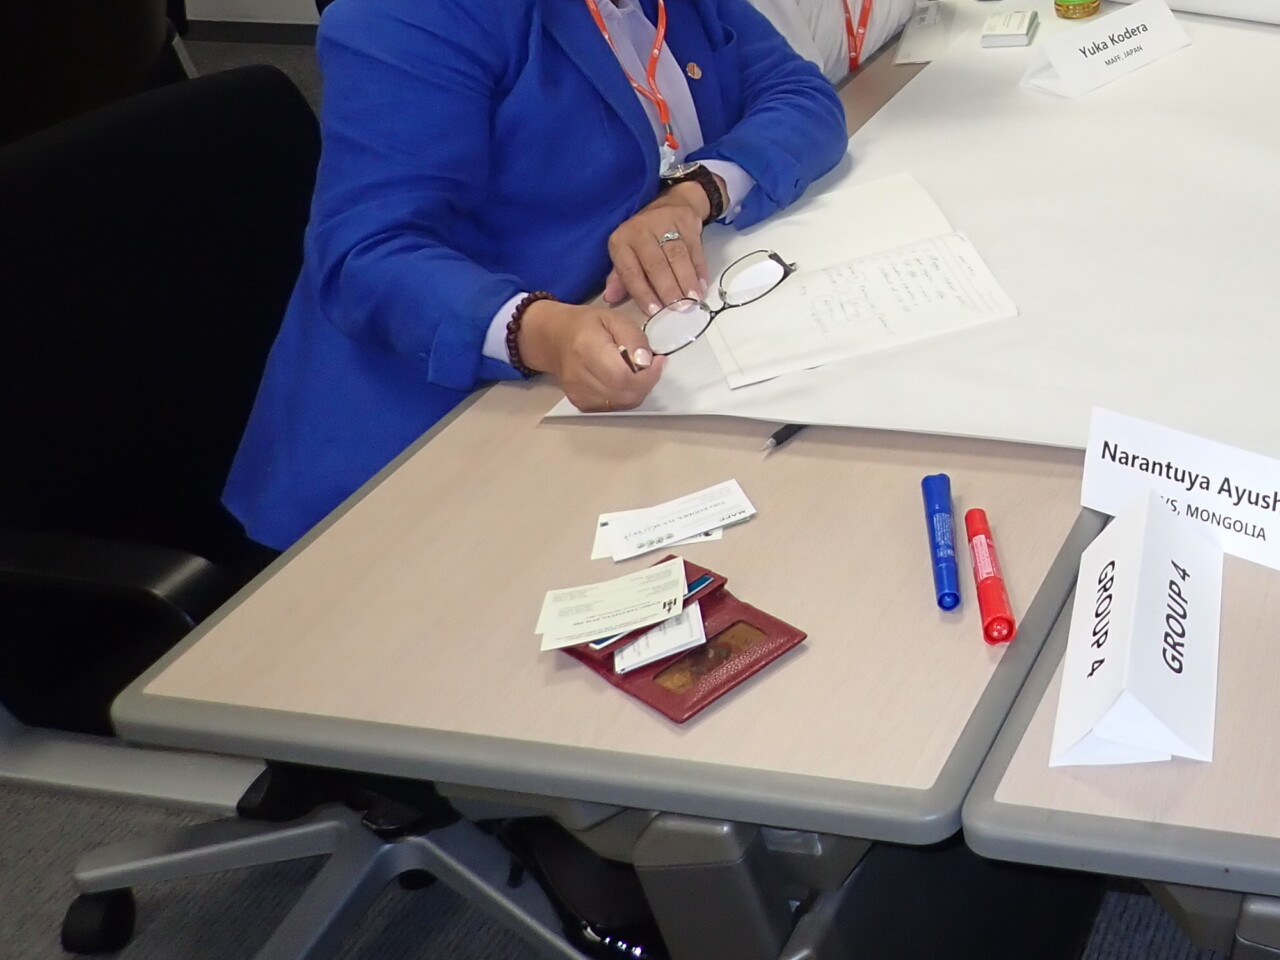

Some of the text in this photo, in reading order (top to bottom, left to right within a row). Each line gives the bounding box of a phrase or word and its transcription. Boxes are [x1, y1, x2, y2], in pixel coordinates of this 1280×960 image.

[1078, 23, 1148, 58] Yuka Kodera
[1123, 45, 1143, 58] JAPAN
[1101, 440, 1210, 491] Narantuya
[1185, 504, 1267, 541] MONGOLIA
[1087, 560, 1115, 679] GROUP 4
[1162, 559, 1191, 674] GROUP 4
